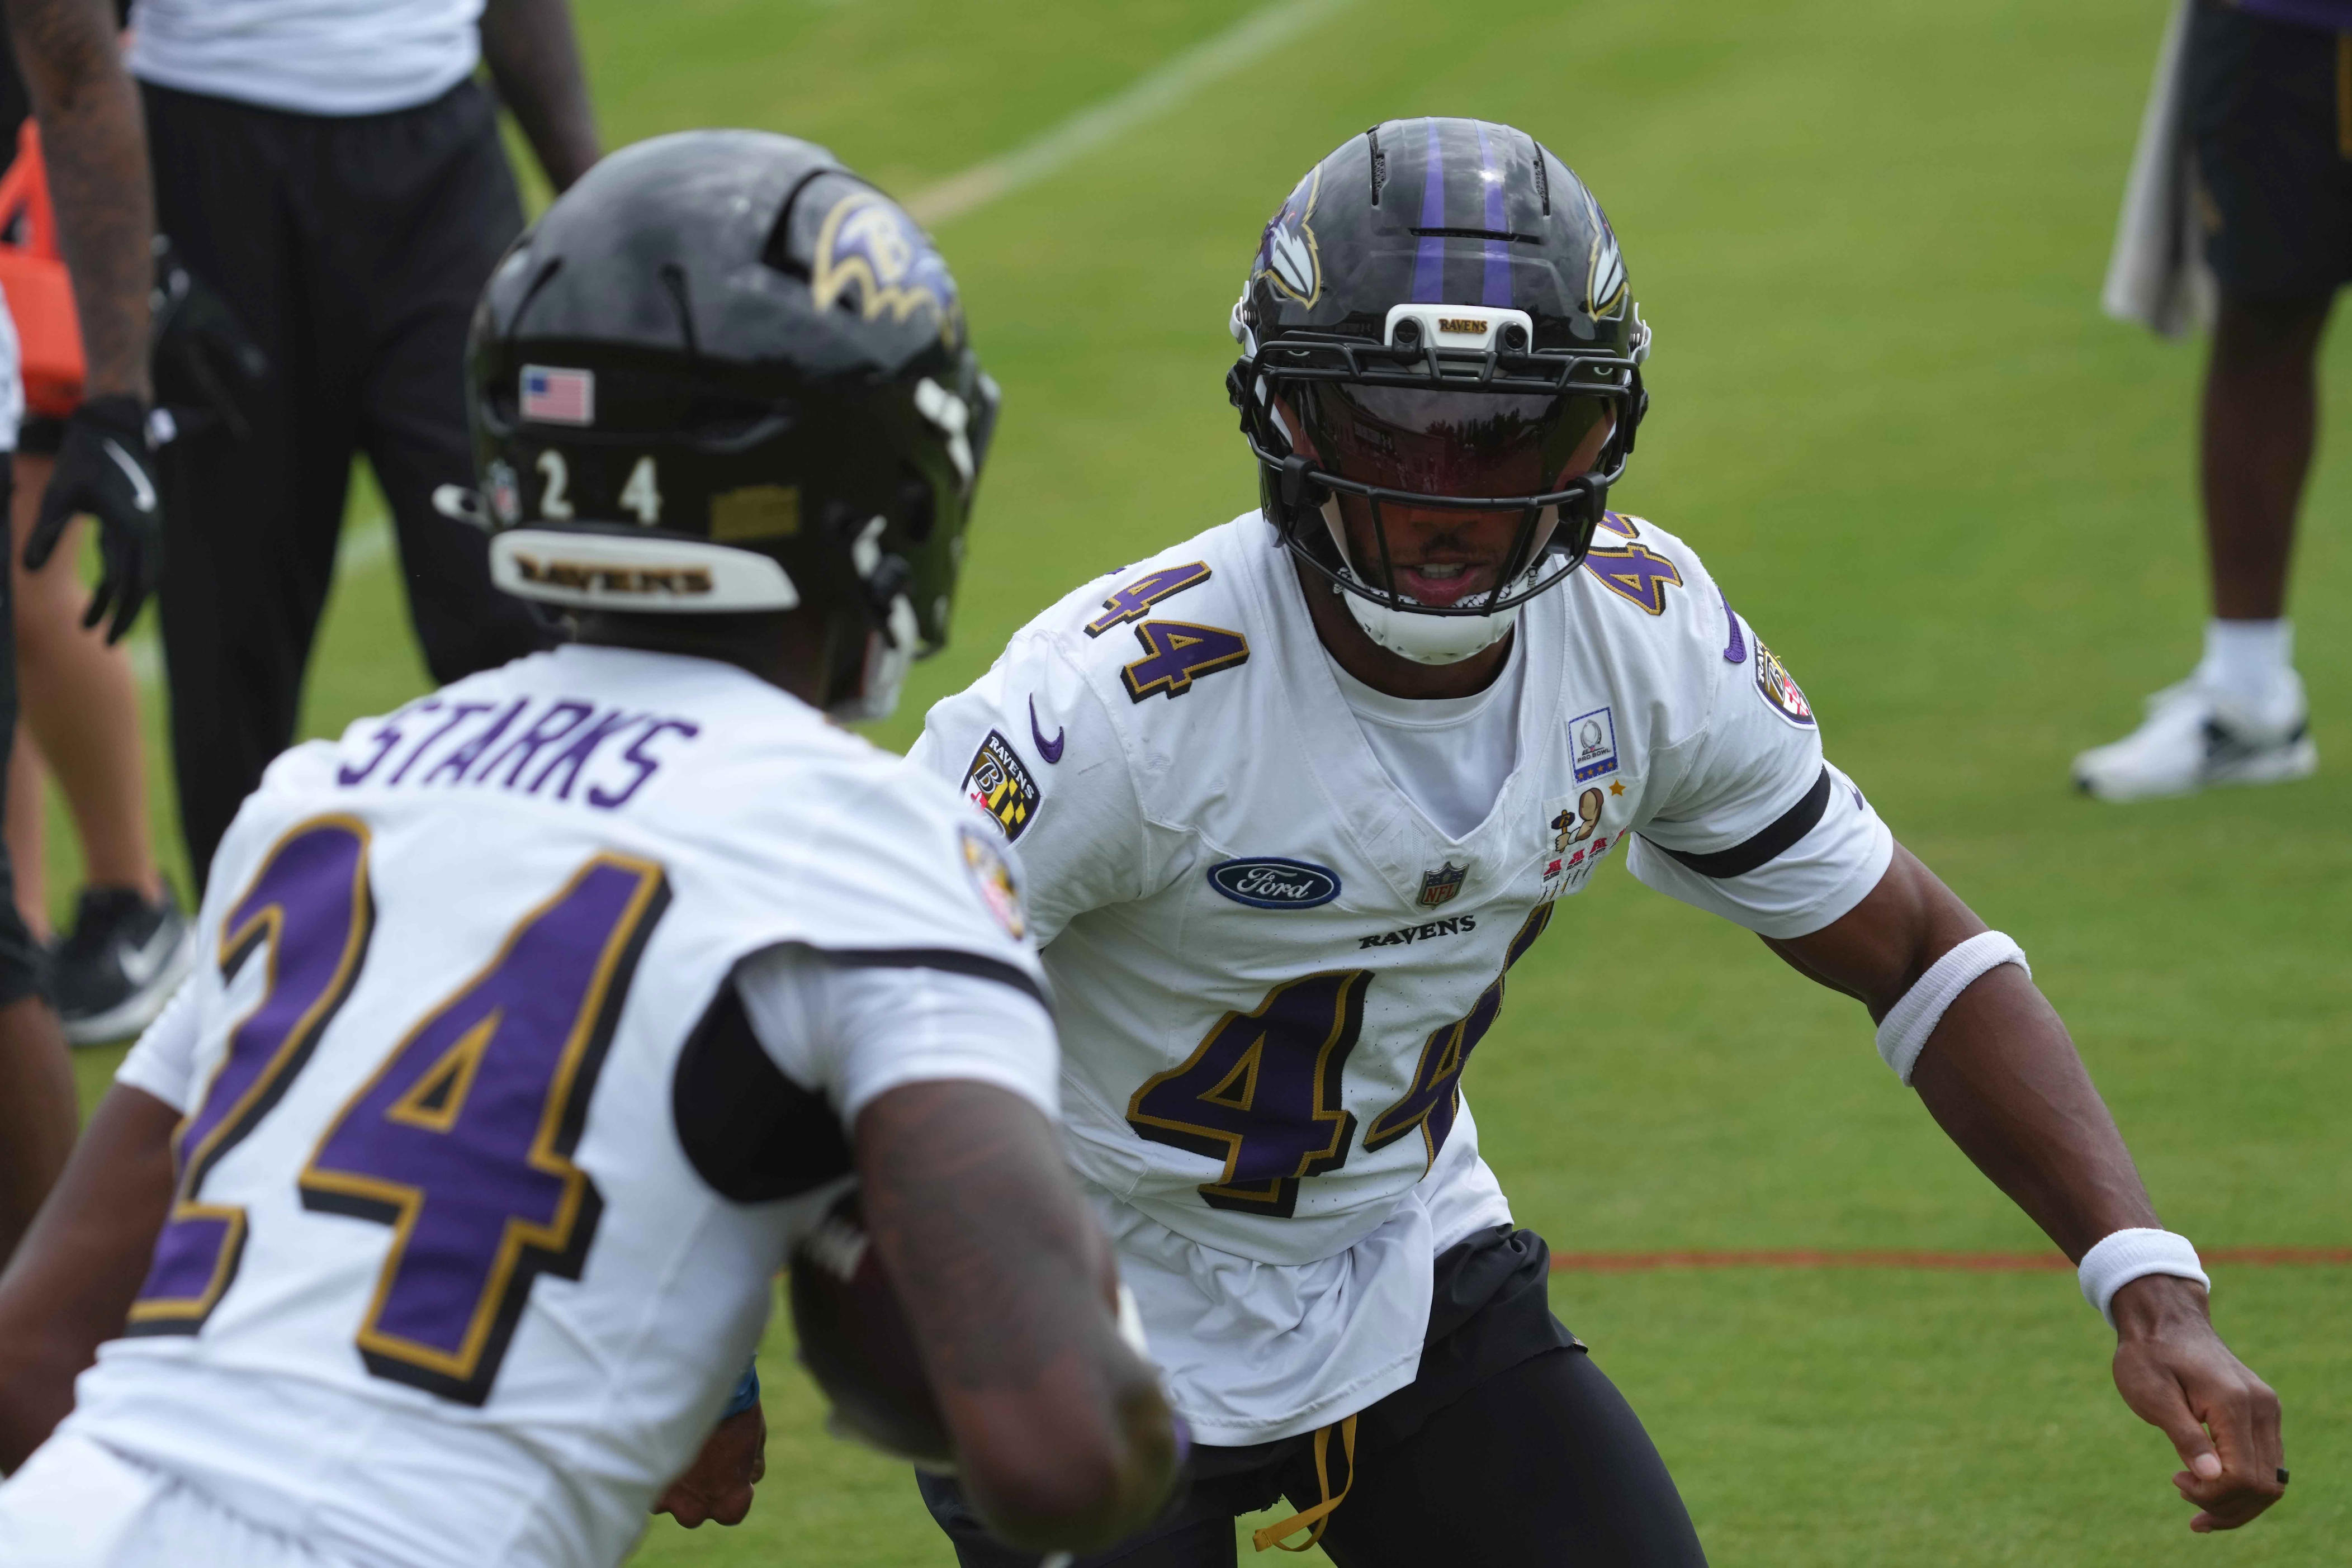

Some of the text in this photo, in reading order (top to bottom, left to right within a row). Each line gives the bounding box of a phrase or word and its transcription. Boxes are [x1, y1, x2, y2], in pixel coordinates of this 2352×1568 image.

[1438, 319, 1488, 334] RAVENS
[1083, 560, 1250, 704] 44
[337, 694, 699, 811] STARKS
[988, 736, 1034, 799] RAVENS
[1577, 748, 1611, 764] PRO BOWL
[1237, 868, 1314, 899] Ford
[1423, 884, 1455, 903] NFL
[1359, 915, 1476, 949] RAVENS
[1125, 901, 1555, 1219] 44
[125, 812, 676, 1408] 24
